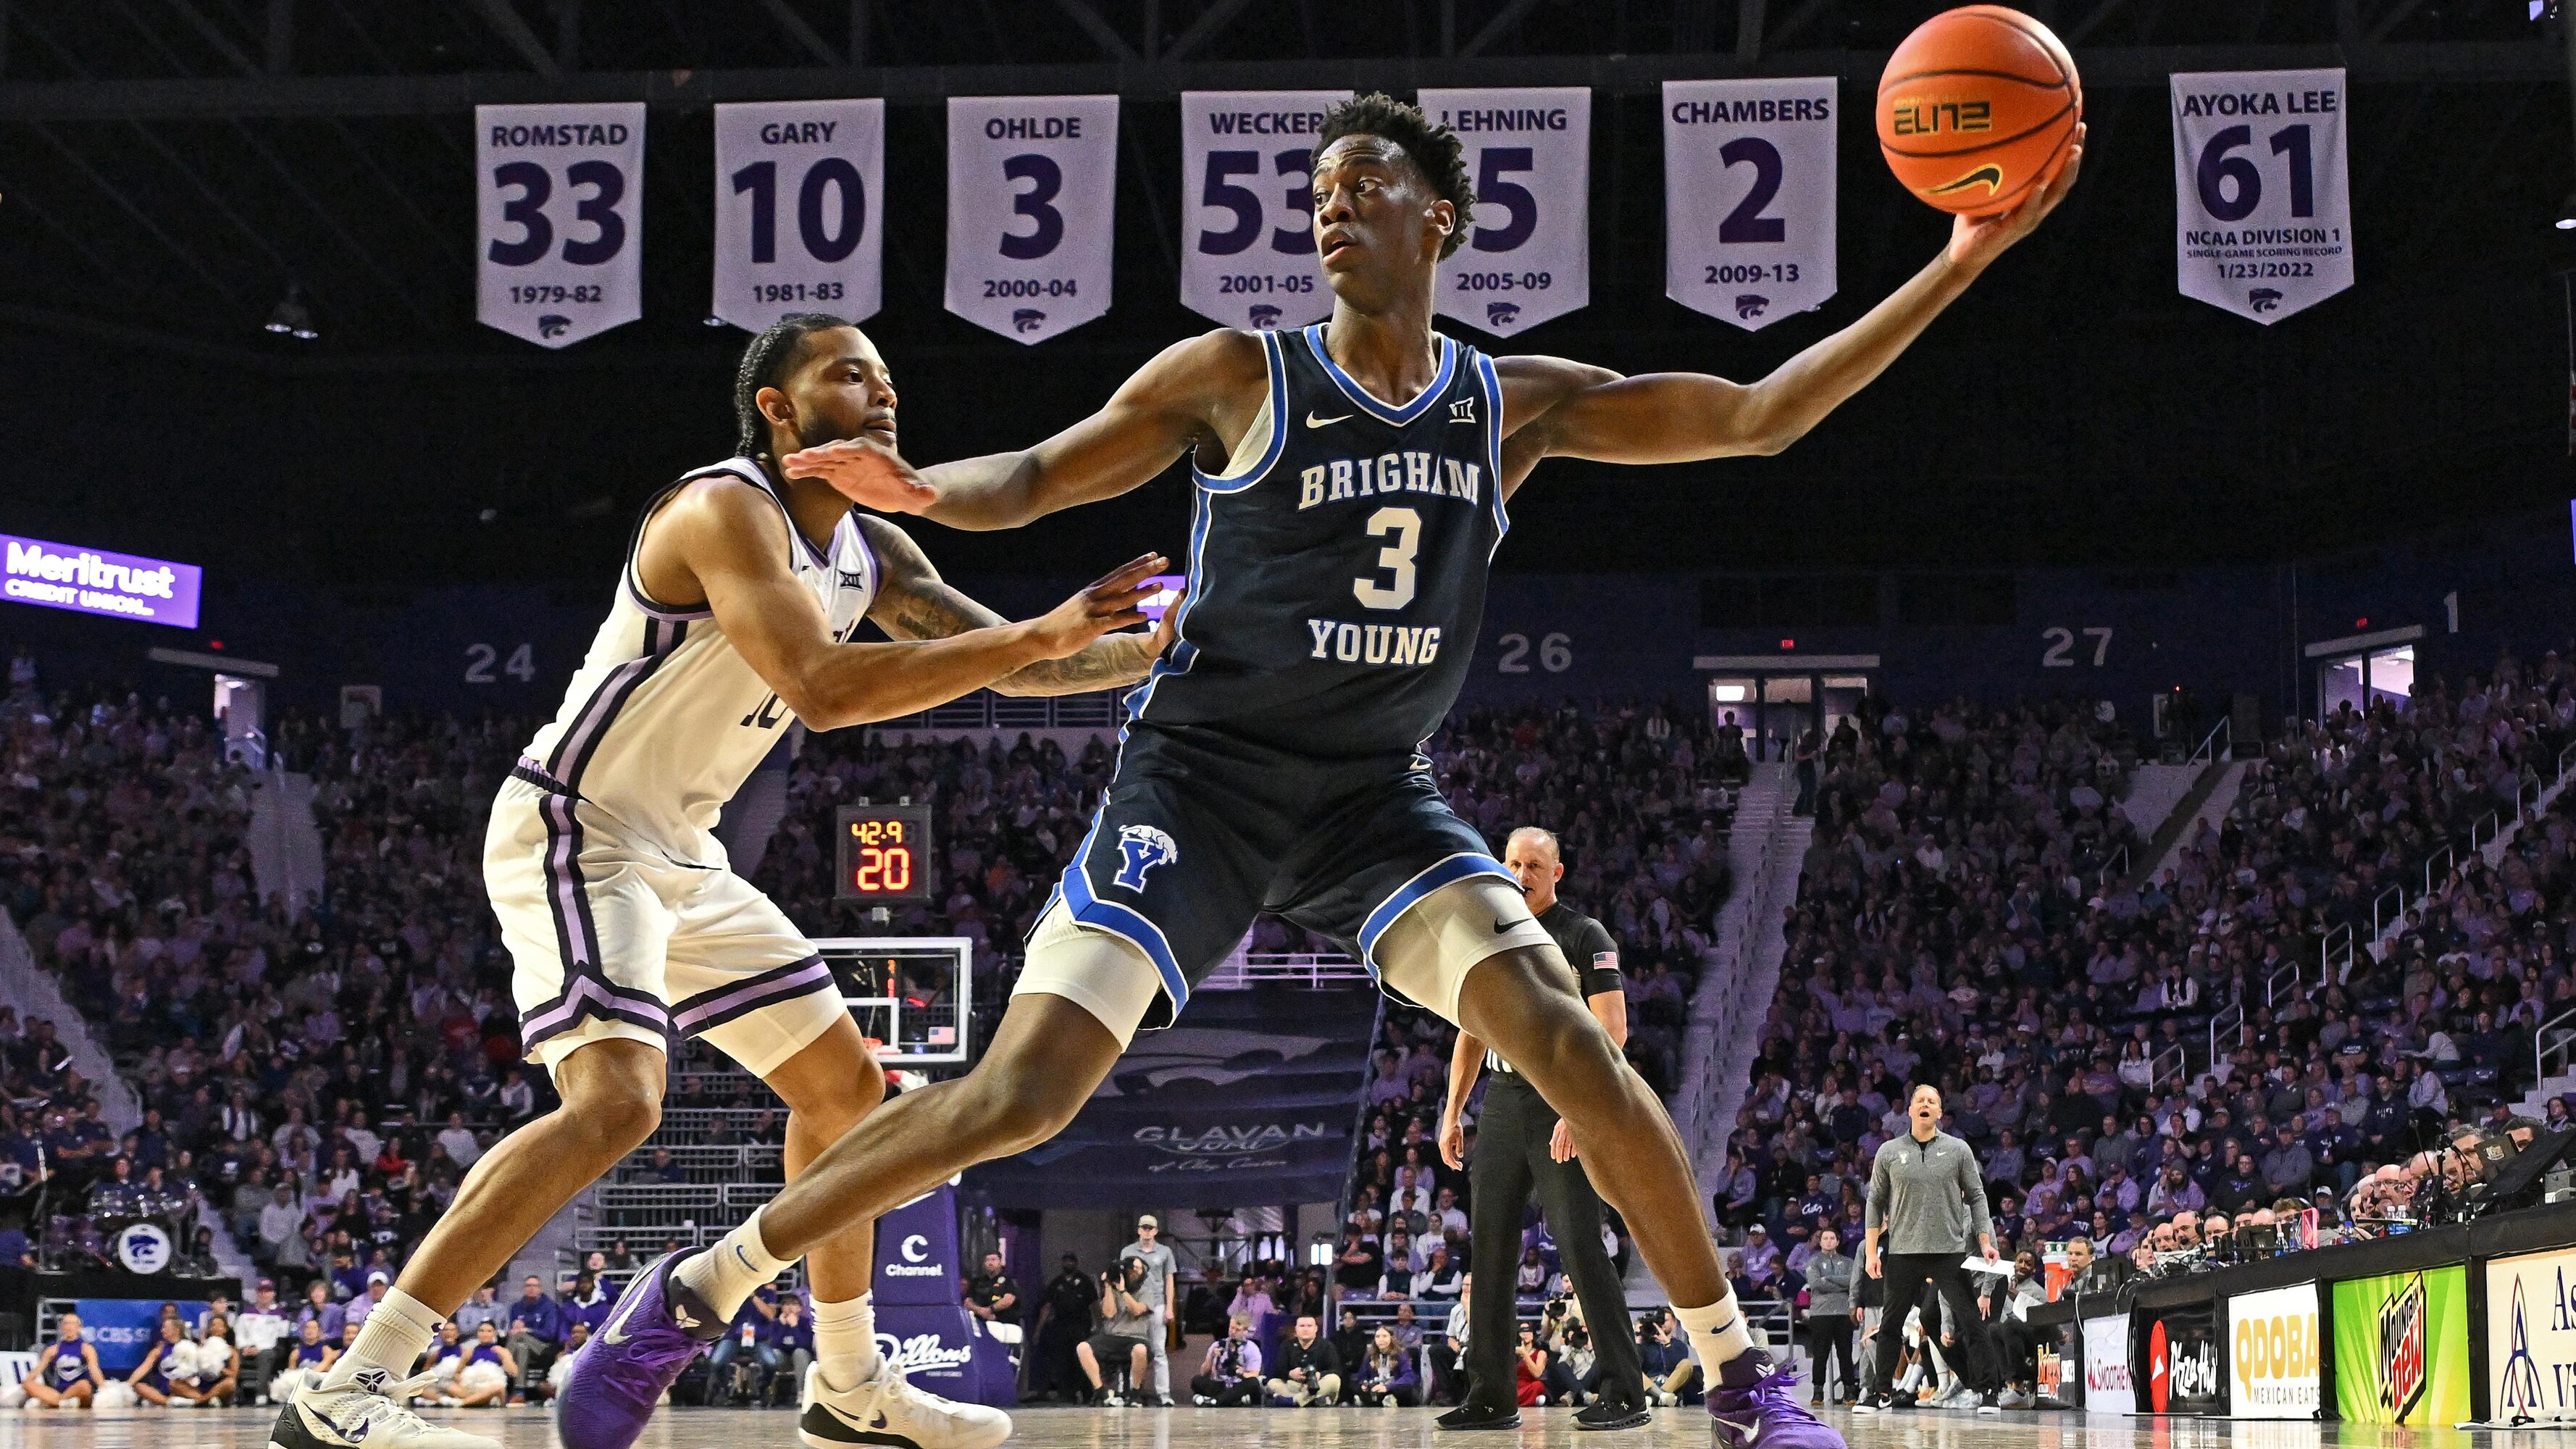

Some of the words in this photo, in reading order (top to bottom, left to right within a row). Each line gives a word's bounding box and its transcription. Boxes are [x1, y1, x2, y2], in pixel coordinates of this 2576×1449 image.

[1673, 99, 1828, 124] CHAMBERS
[2183, 93, 2280, 117] AYOKA
[2287, 91, 2336, 114] LEE
[492, 124, 628, 147] ROMSTAD
[761, 122, 836, 145] GARY
[985, 117, 1081, 139] OHLDE
[2197, 124, 2313, 221] 61
[1198, 149, 1317, 255] 53
[1719, 137, 1786, 244] 2
[488, 161, 625, 266] 33
[732, 158, 865, 263] 10
[999, 154, 1063, 259] 3
[2186, 230, 2237, 246] NCAA
[2243, 228, 2326, 244] DIVISION
[2332, 228, 2341, 242] 1
[2302, 246, 2342, 256] RECORD
[1456, 272, 1552, 291] 2005-09
[1705, 264, 1799, 284] 2009-13
[2217, 263, 2314, 278] 1/23/2022
[509, 285, 602, 304] 1979-82
[753, 282, 844, 303] 1981-83
[984, 279, 1076, 298] 2000-04
[1220, 275, 1314, 293] 2001-05
[6, 541, 175, 599] Meritrust
[1353, 506, 1422, 610] 3
[5, 579, 78, 604] CREDIT
[2443, 590, 2459, 633] 1
[1308, 619, 1441, 665] YOUNG
[1498, 632, 1572, 672] 26
[2042, 627, 2113, 667] 27
[465, 643, 536, 682] 24
[851, 821, 903, 845] 42.9
[857, 848, 910, 891] 20
[2170, 1340, 2197, 1400] Pizza
[2236, 1312, 2319, 1403] QDOBA
[2254, 1386, 2293, 1406] MEXICAN
